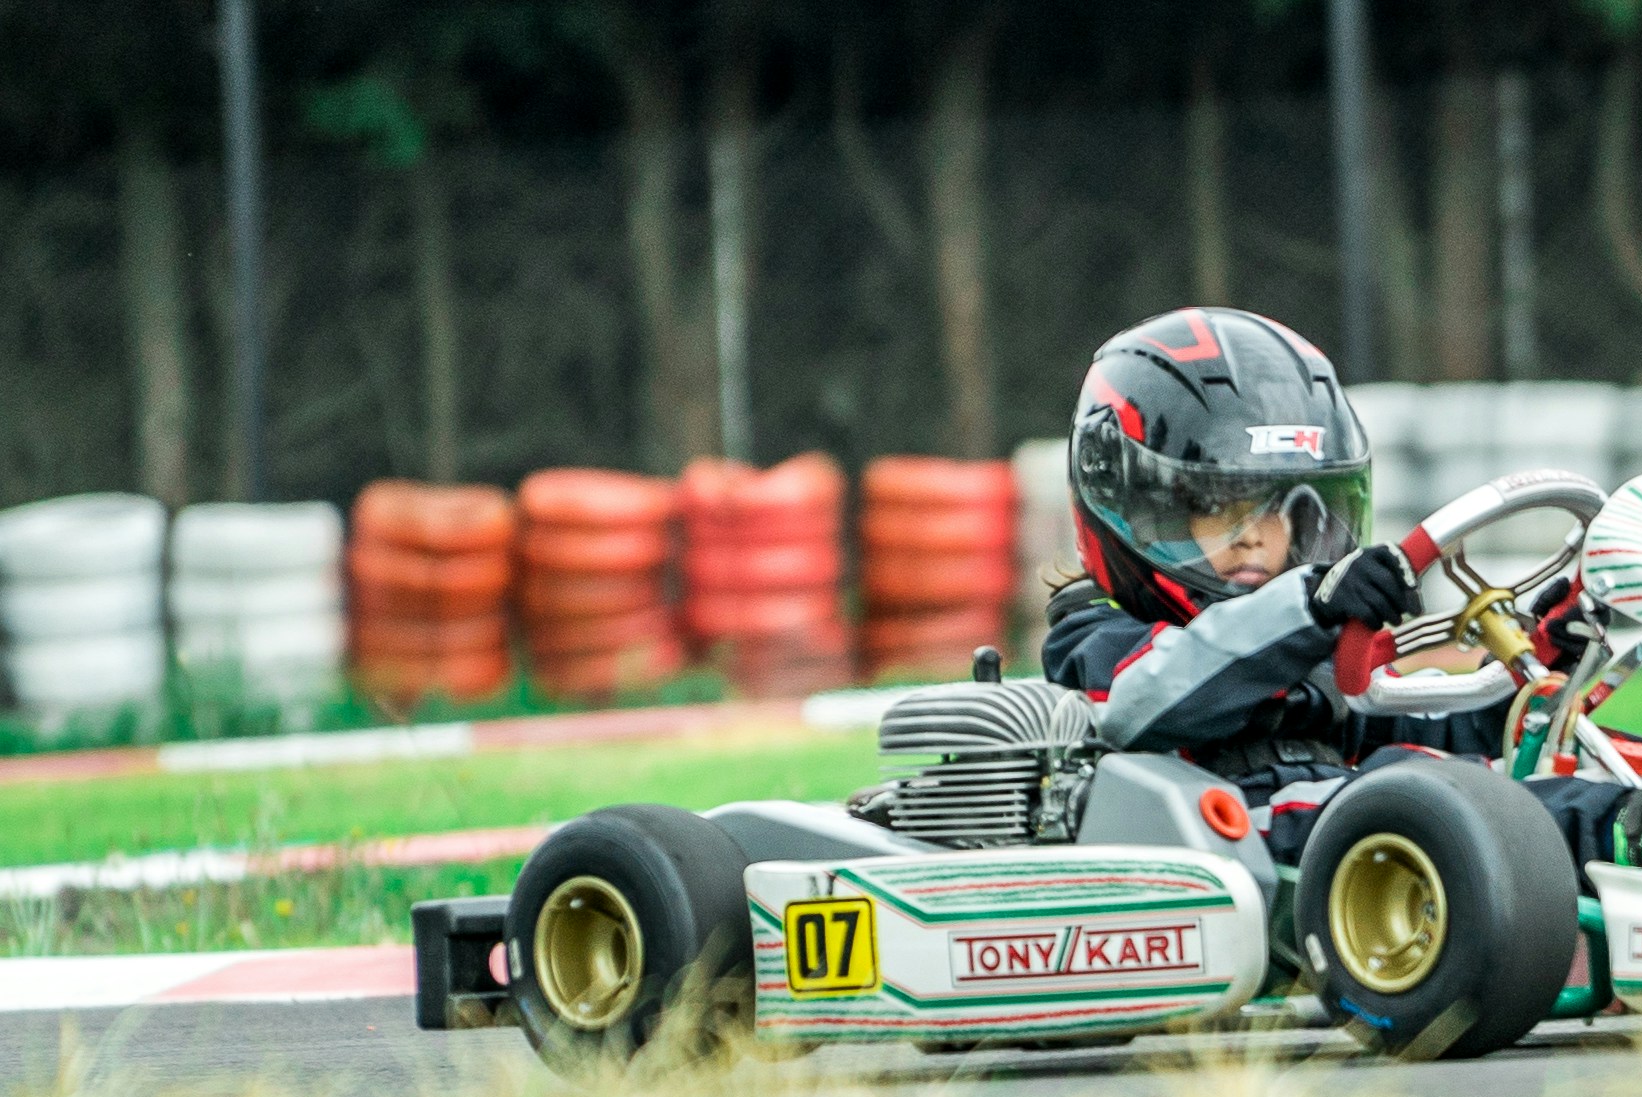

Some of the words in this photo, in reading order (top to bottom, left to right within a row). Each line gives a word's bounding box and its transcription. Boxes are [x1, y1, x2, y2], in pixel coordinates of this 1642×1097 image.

[797, 910, 861, 979] 07
[954, 933, 1057, 974] TONY
[1084, 924, 1197, 967] KART
